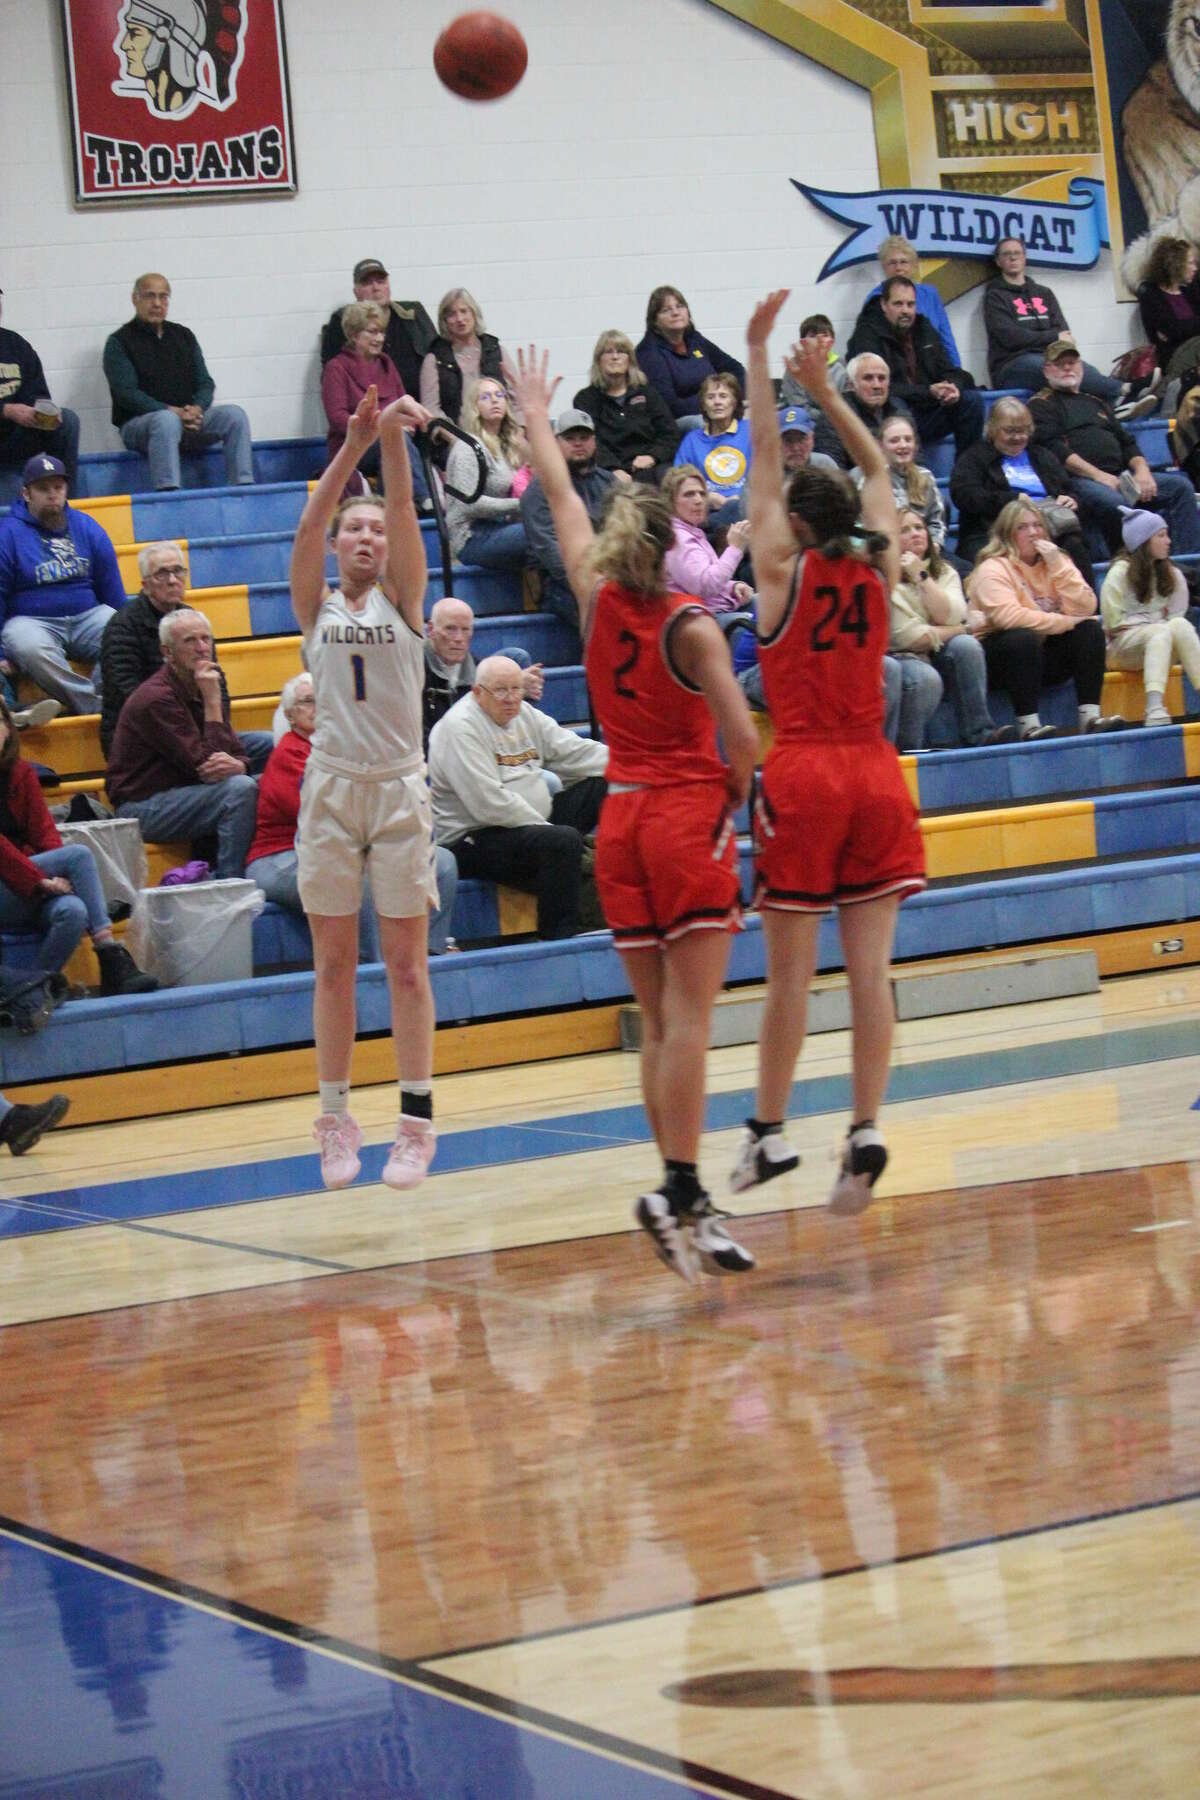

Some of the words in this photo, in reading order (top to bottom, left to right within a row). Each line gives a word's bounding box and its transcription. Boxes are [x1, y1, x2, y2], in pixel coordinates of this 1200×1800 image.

[951, 99, 1081, 141] HIGH
[83, 125, 284, 188] TROJANS
[877, 203, 1076, 254] WILDCAT
[321, 623, 397, 645] WILDCATS
[810, 582, 870, 652] 24
[349, 653, 368, 702] 1
[613, 629, 641, 699] 2
